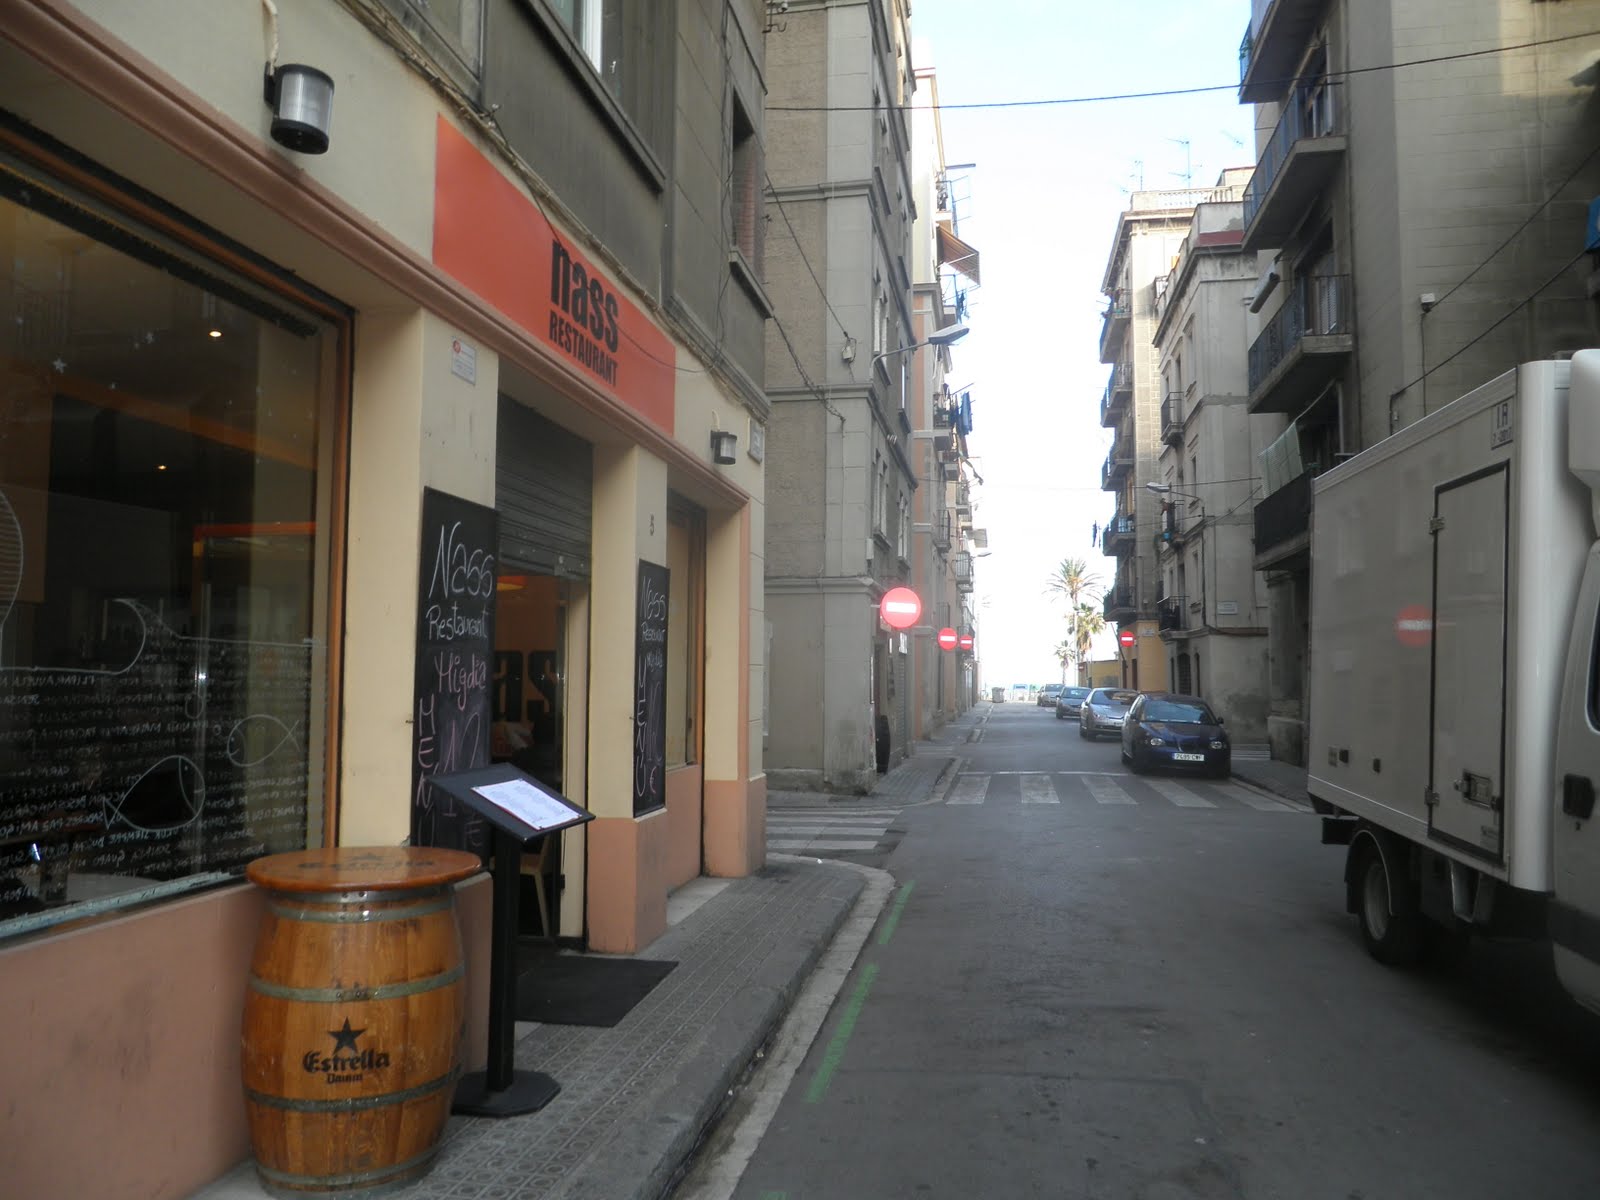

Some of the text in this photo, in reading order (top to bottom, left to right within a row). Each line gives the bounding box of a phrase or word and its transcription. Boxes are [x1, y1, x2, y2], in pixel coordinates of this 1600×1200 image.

[550, 310, 618, 386] RESTAURANT
[429, 521, 493, 598] Nass
[426, 601, 489, 641] Restaurant
[303, 1048, 390, 1074] Estrella
